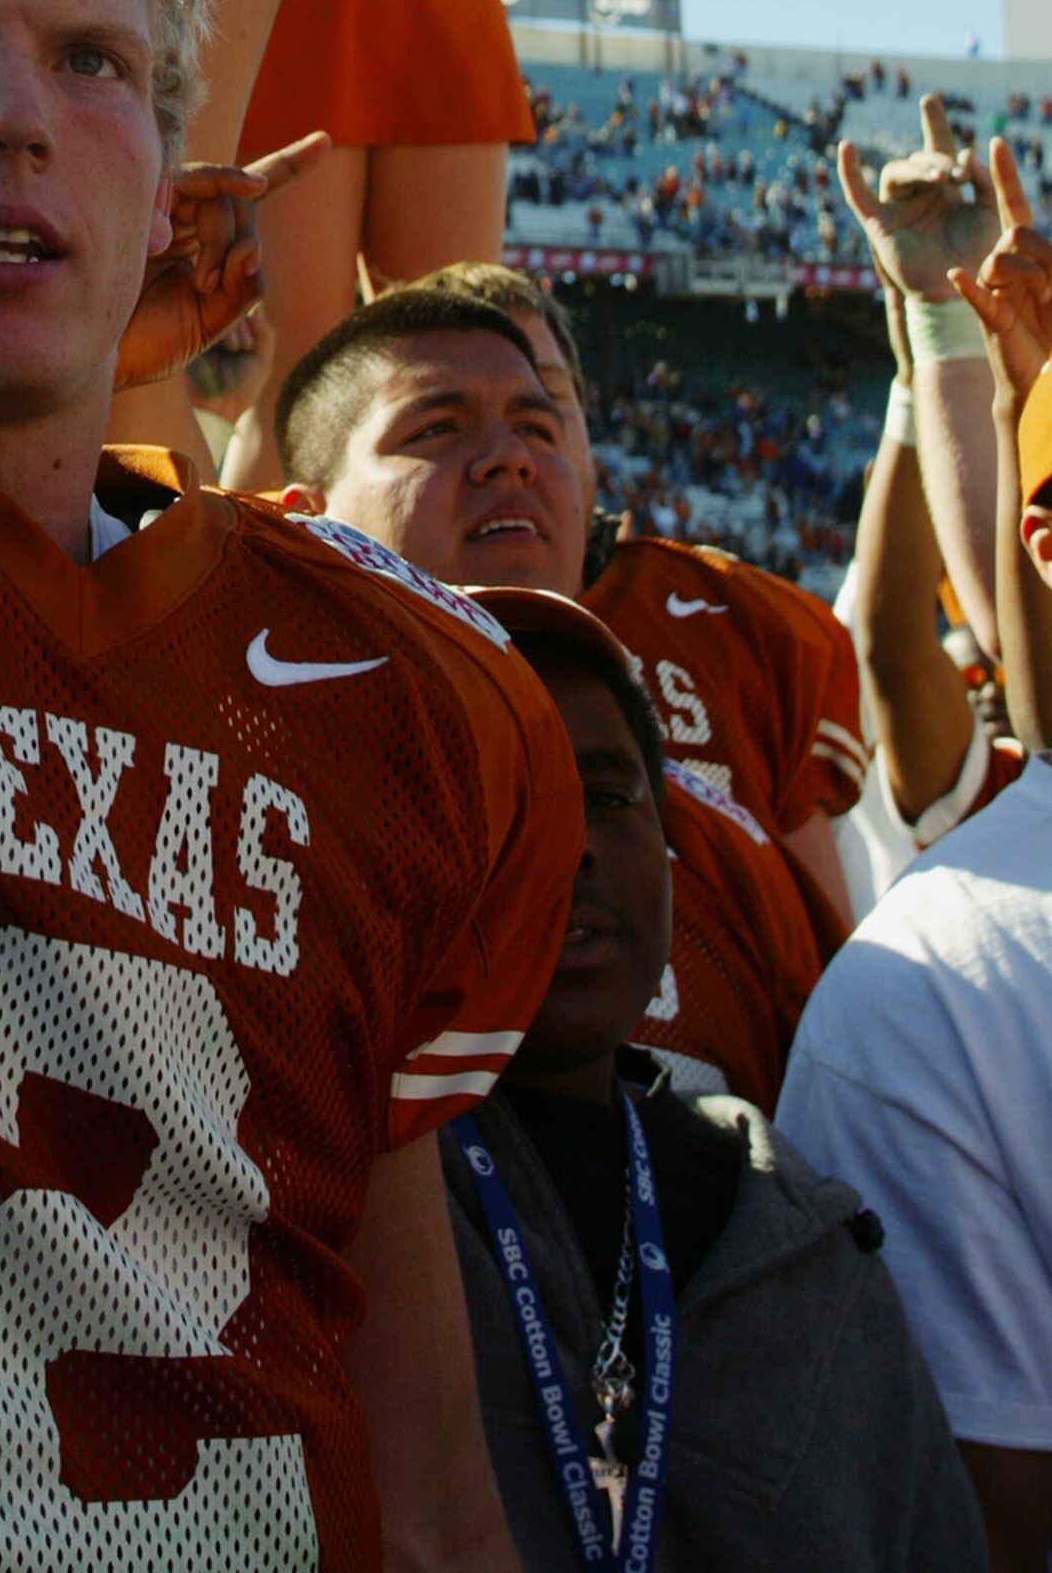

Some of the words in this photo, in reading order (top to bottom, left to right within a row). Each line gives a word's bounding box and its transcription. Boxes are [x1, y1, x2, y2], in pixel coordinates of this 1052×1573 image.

[498, 1227, 529, 1281] SBC
[515, 1286, 552, 1378] Cotton
[541, 1384, 579, 1456] Bowl
[562, 1461, 604, 1562] Classic
[650, 1312, 673, 1405] Classic
[637, 1409, 667, 1480] Bowl
